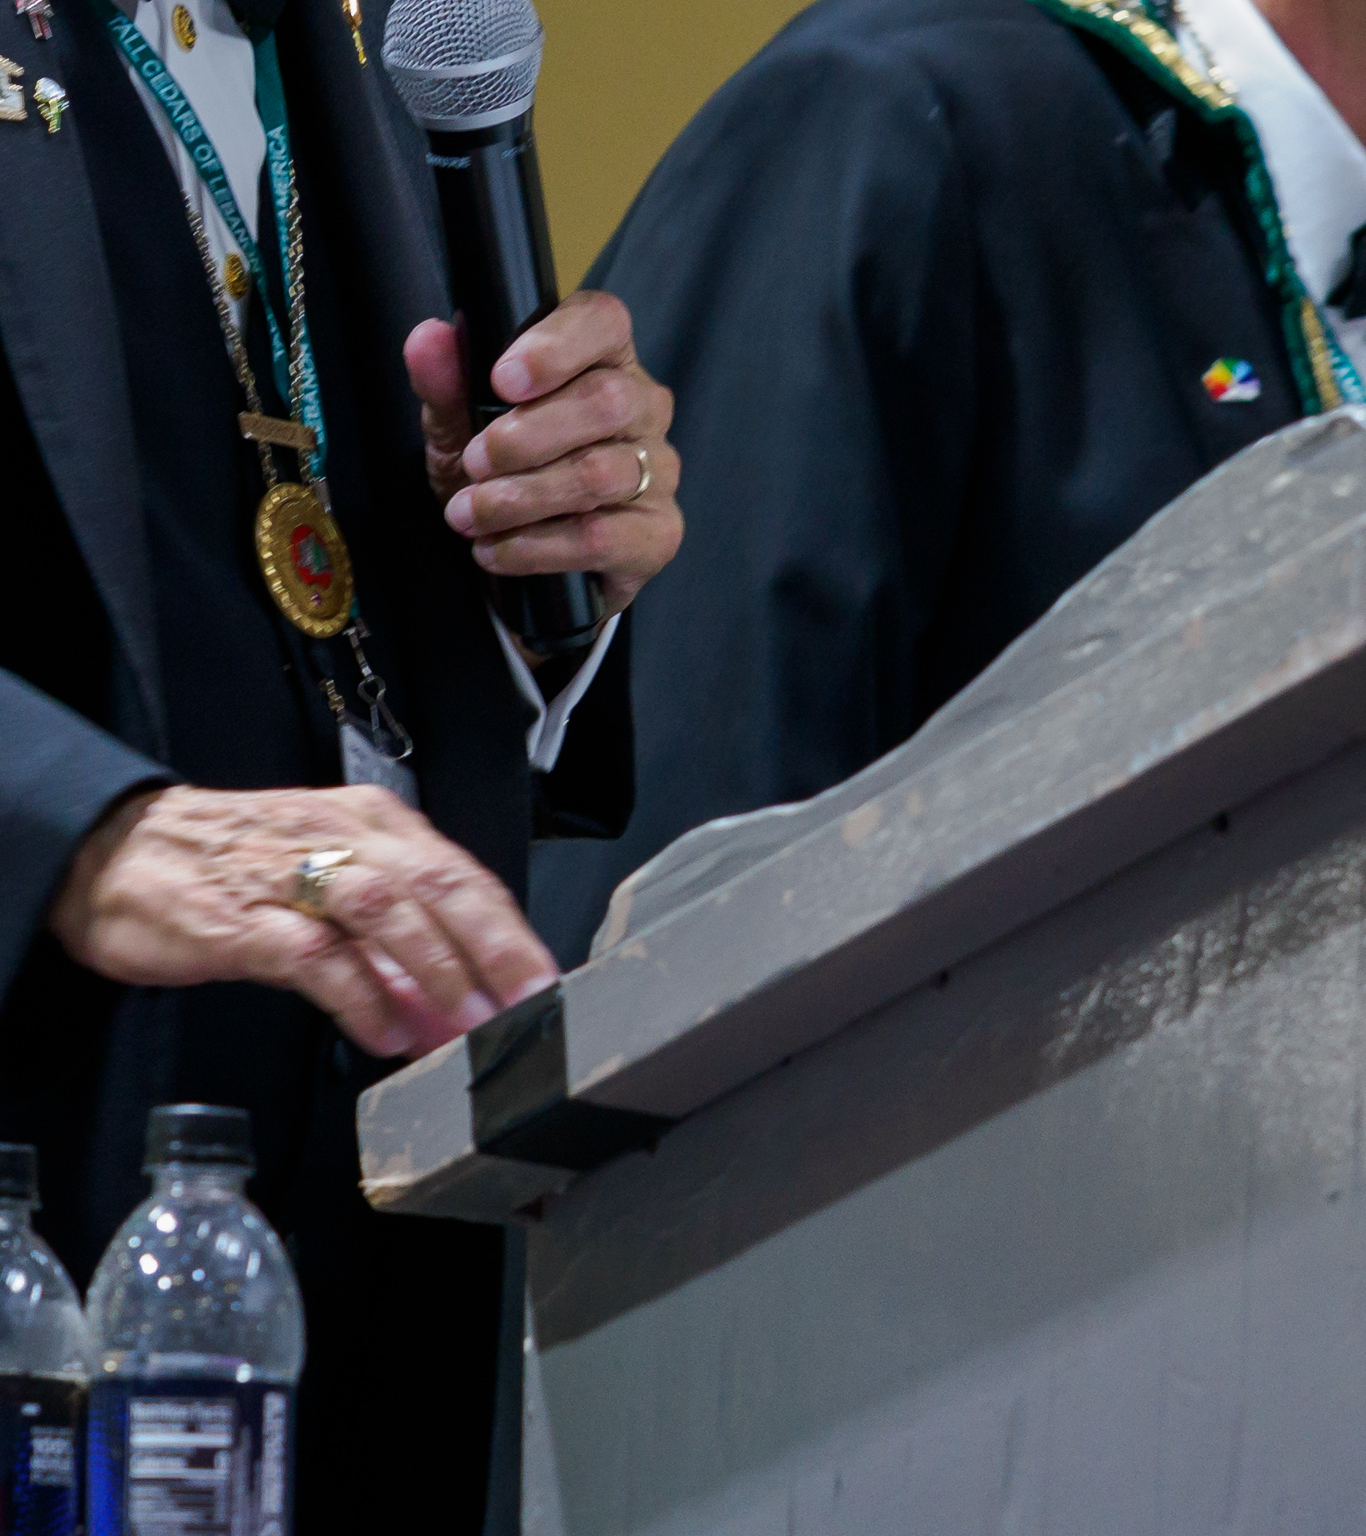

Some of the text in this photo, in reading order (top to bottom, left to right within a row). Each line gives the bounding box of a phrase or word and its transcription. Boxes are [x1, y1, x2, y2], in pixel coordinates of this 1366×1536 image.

[109, 13, 147, 62] TALL
[140, 59, 203, 143] CEDARS
[193, 143, 222, 170] OF
